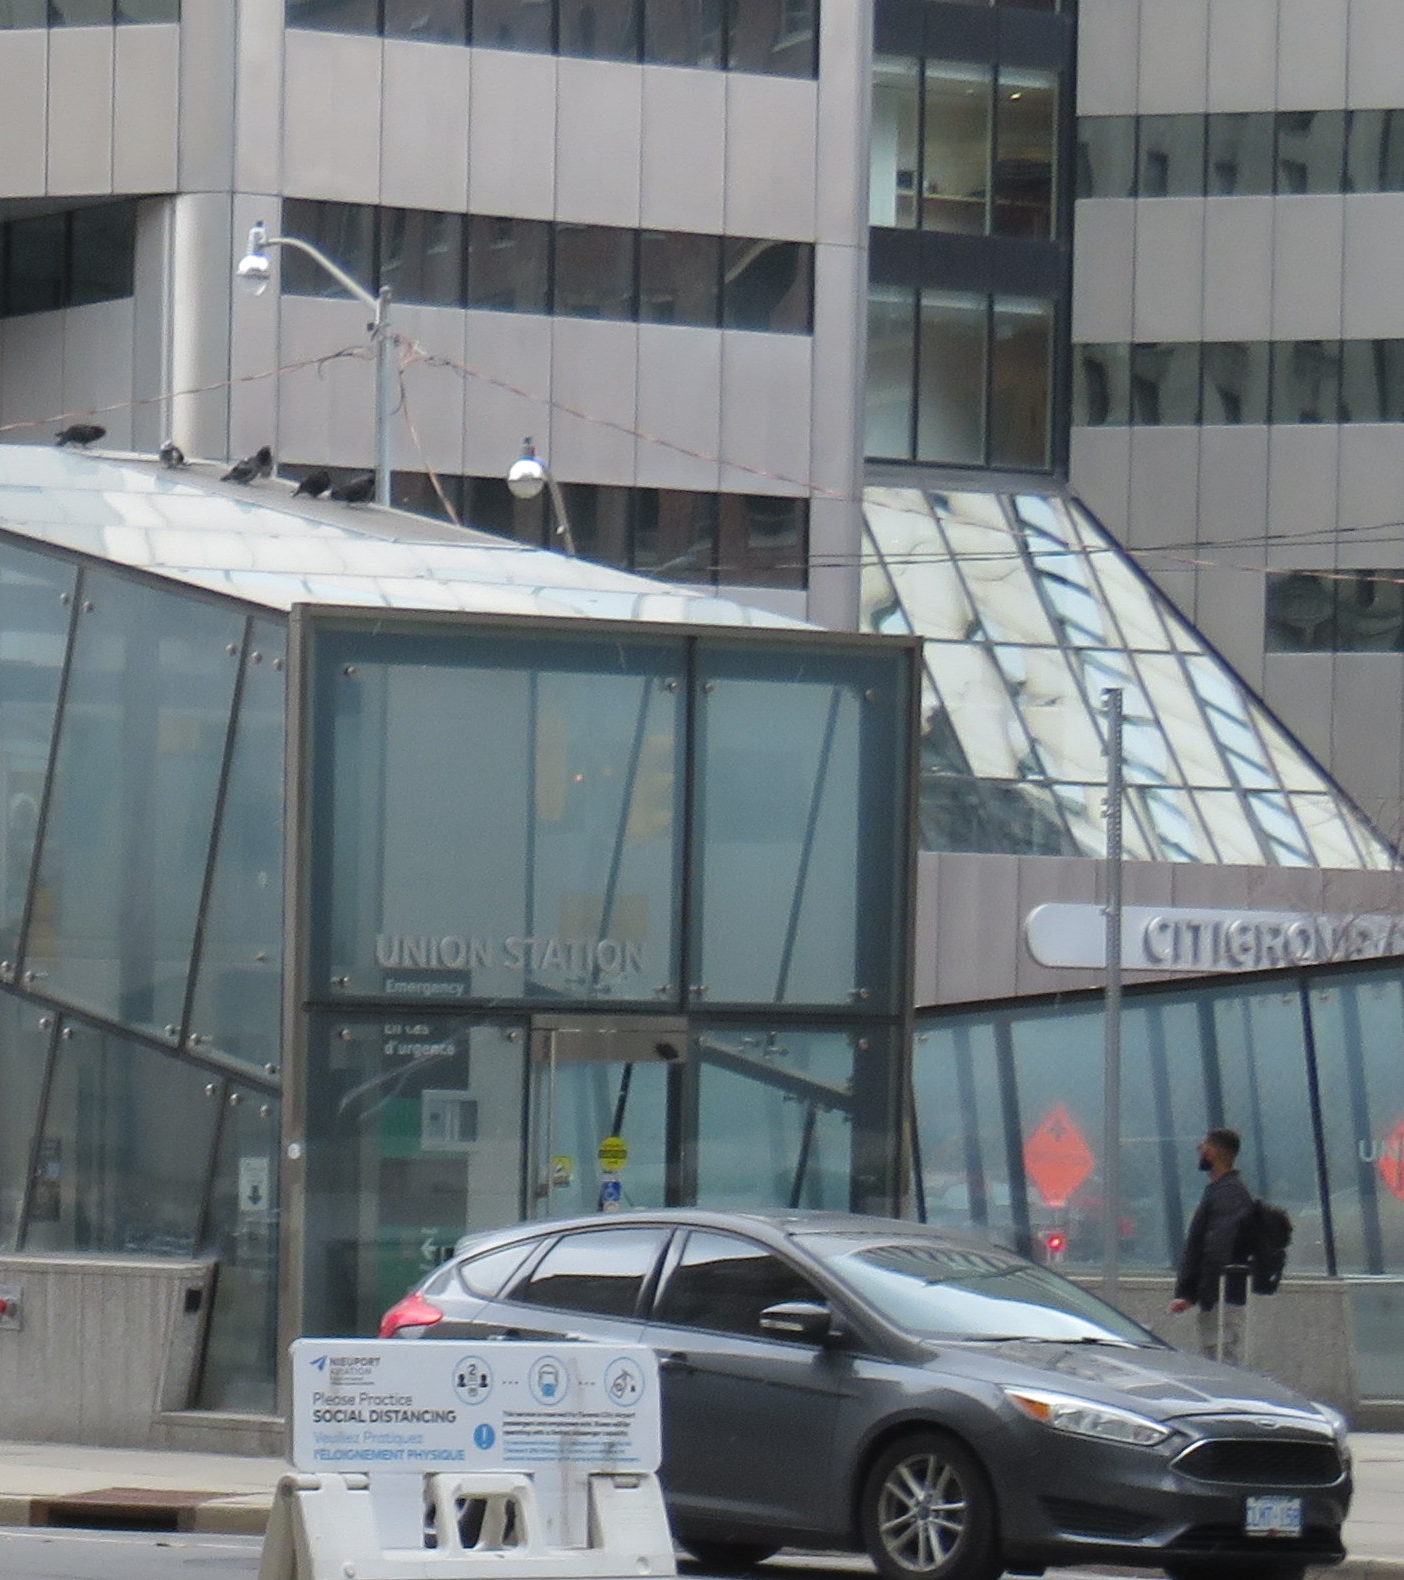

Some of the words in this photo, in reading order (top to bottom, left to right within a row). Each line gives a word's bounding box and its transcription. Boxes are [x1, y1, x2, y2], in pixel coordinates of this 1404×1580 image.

[377, 934, 492, 970] UNION
[504, 936, 649, 978] STATION
[386, 978, 465, 997] Emergency
[313, 1392, 356, 1406] Please
[359, 1392, 413, 1407] Practice
[313, 1409, 366, 1423] SOCIAL
[369, 1410, 457, 1424] DISTANCING
[407, 1449, 466, 1462] PHYSIQUE
